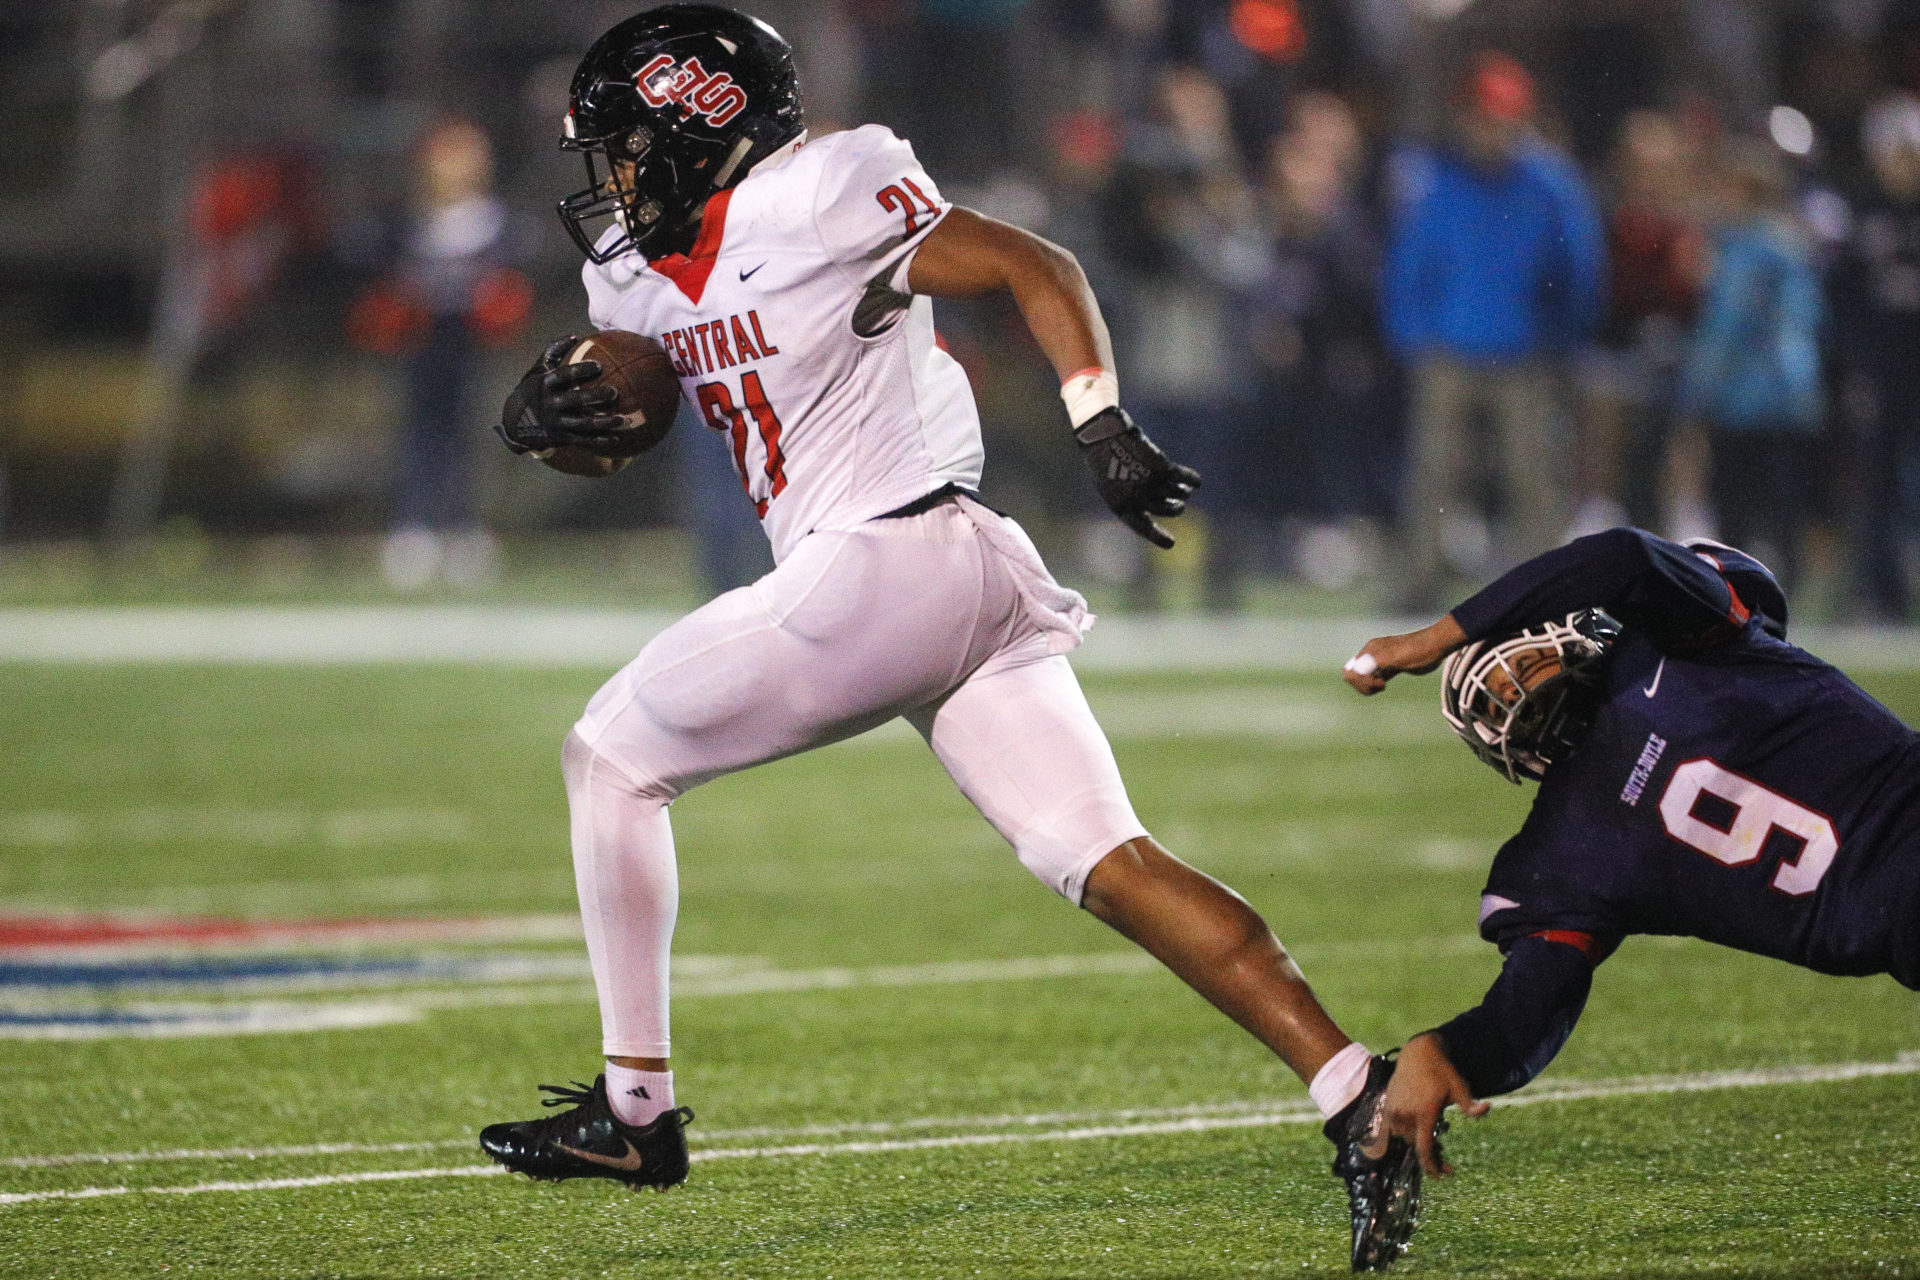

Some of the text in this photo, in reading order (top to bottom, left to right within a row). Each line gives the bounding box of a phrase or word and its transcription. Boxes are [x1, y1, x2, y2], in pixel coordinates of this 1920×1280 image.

[876, 176, 942, 240] 21
[662, 309, 779, 378] CENTRAL
[1620, 732, 1667, 807] SOUTH-DOYLE
[1656, 755, 1842, 897] 9
